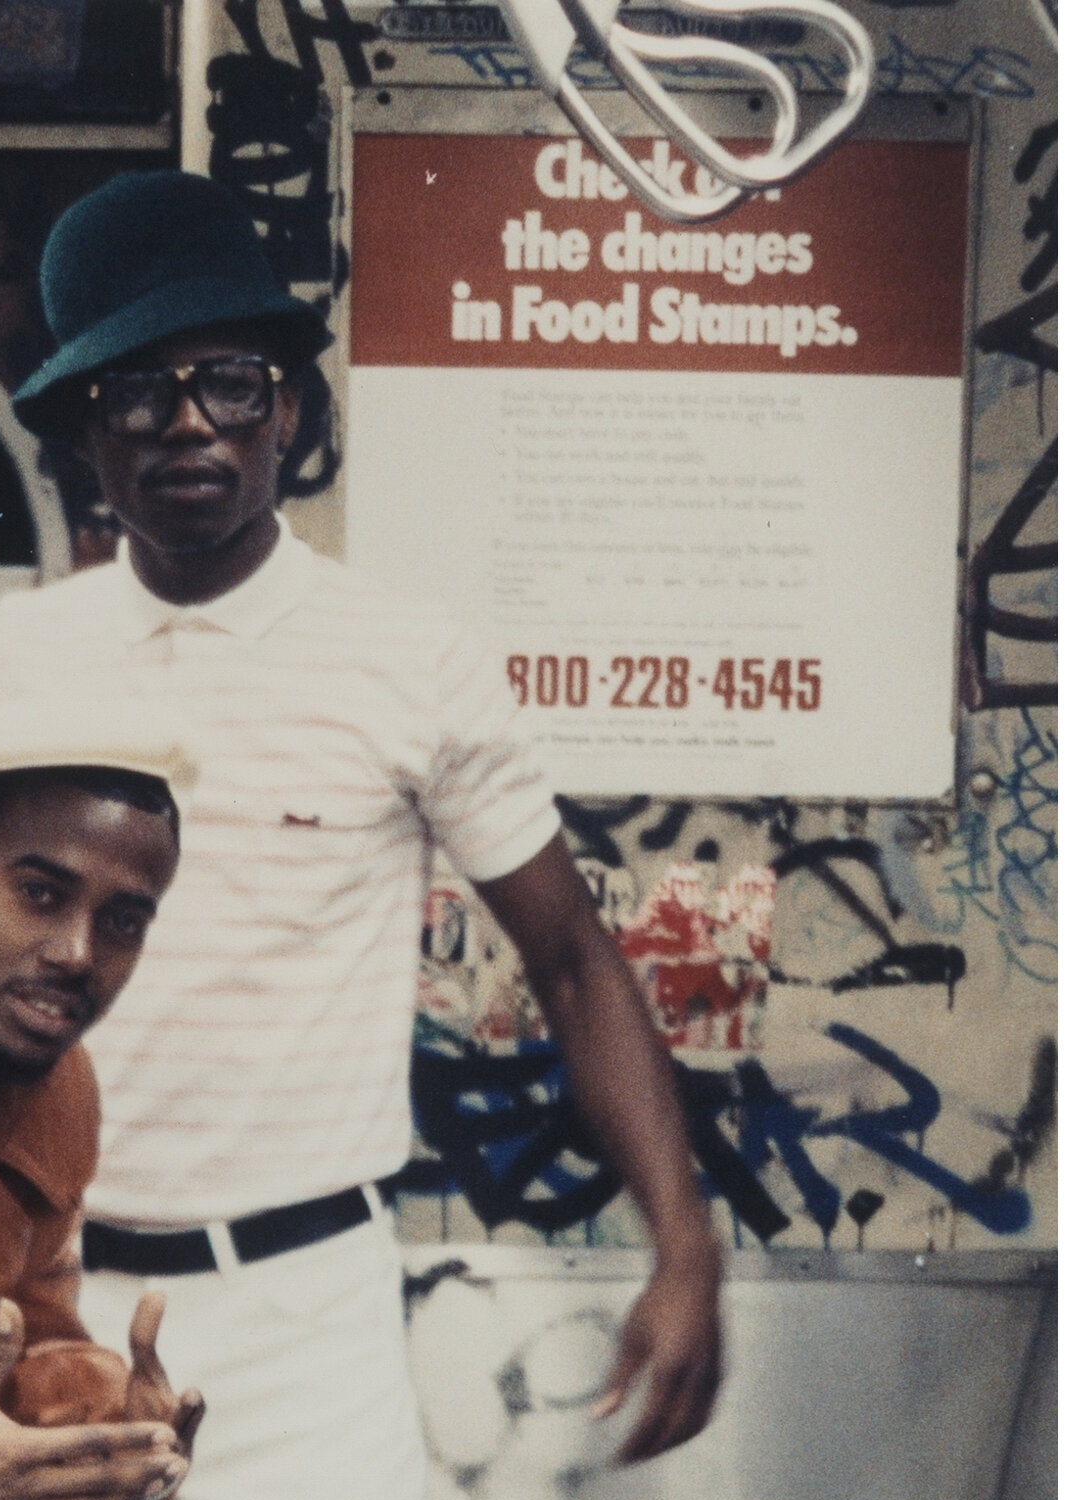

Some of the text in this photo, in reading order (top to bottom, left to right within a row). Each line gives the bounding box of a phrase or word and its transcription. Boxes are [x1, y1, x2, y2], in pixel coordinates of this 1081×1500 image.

[534, 139, 689, 201] Chek
[502, 211, 813, 285] the changes
[451, 281, 858, 357] in Food Stamps.
